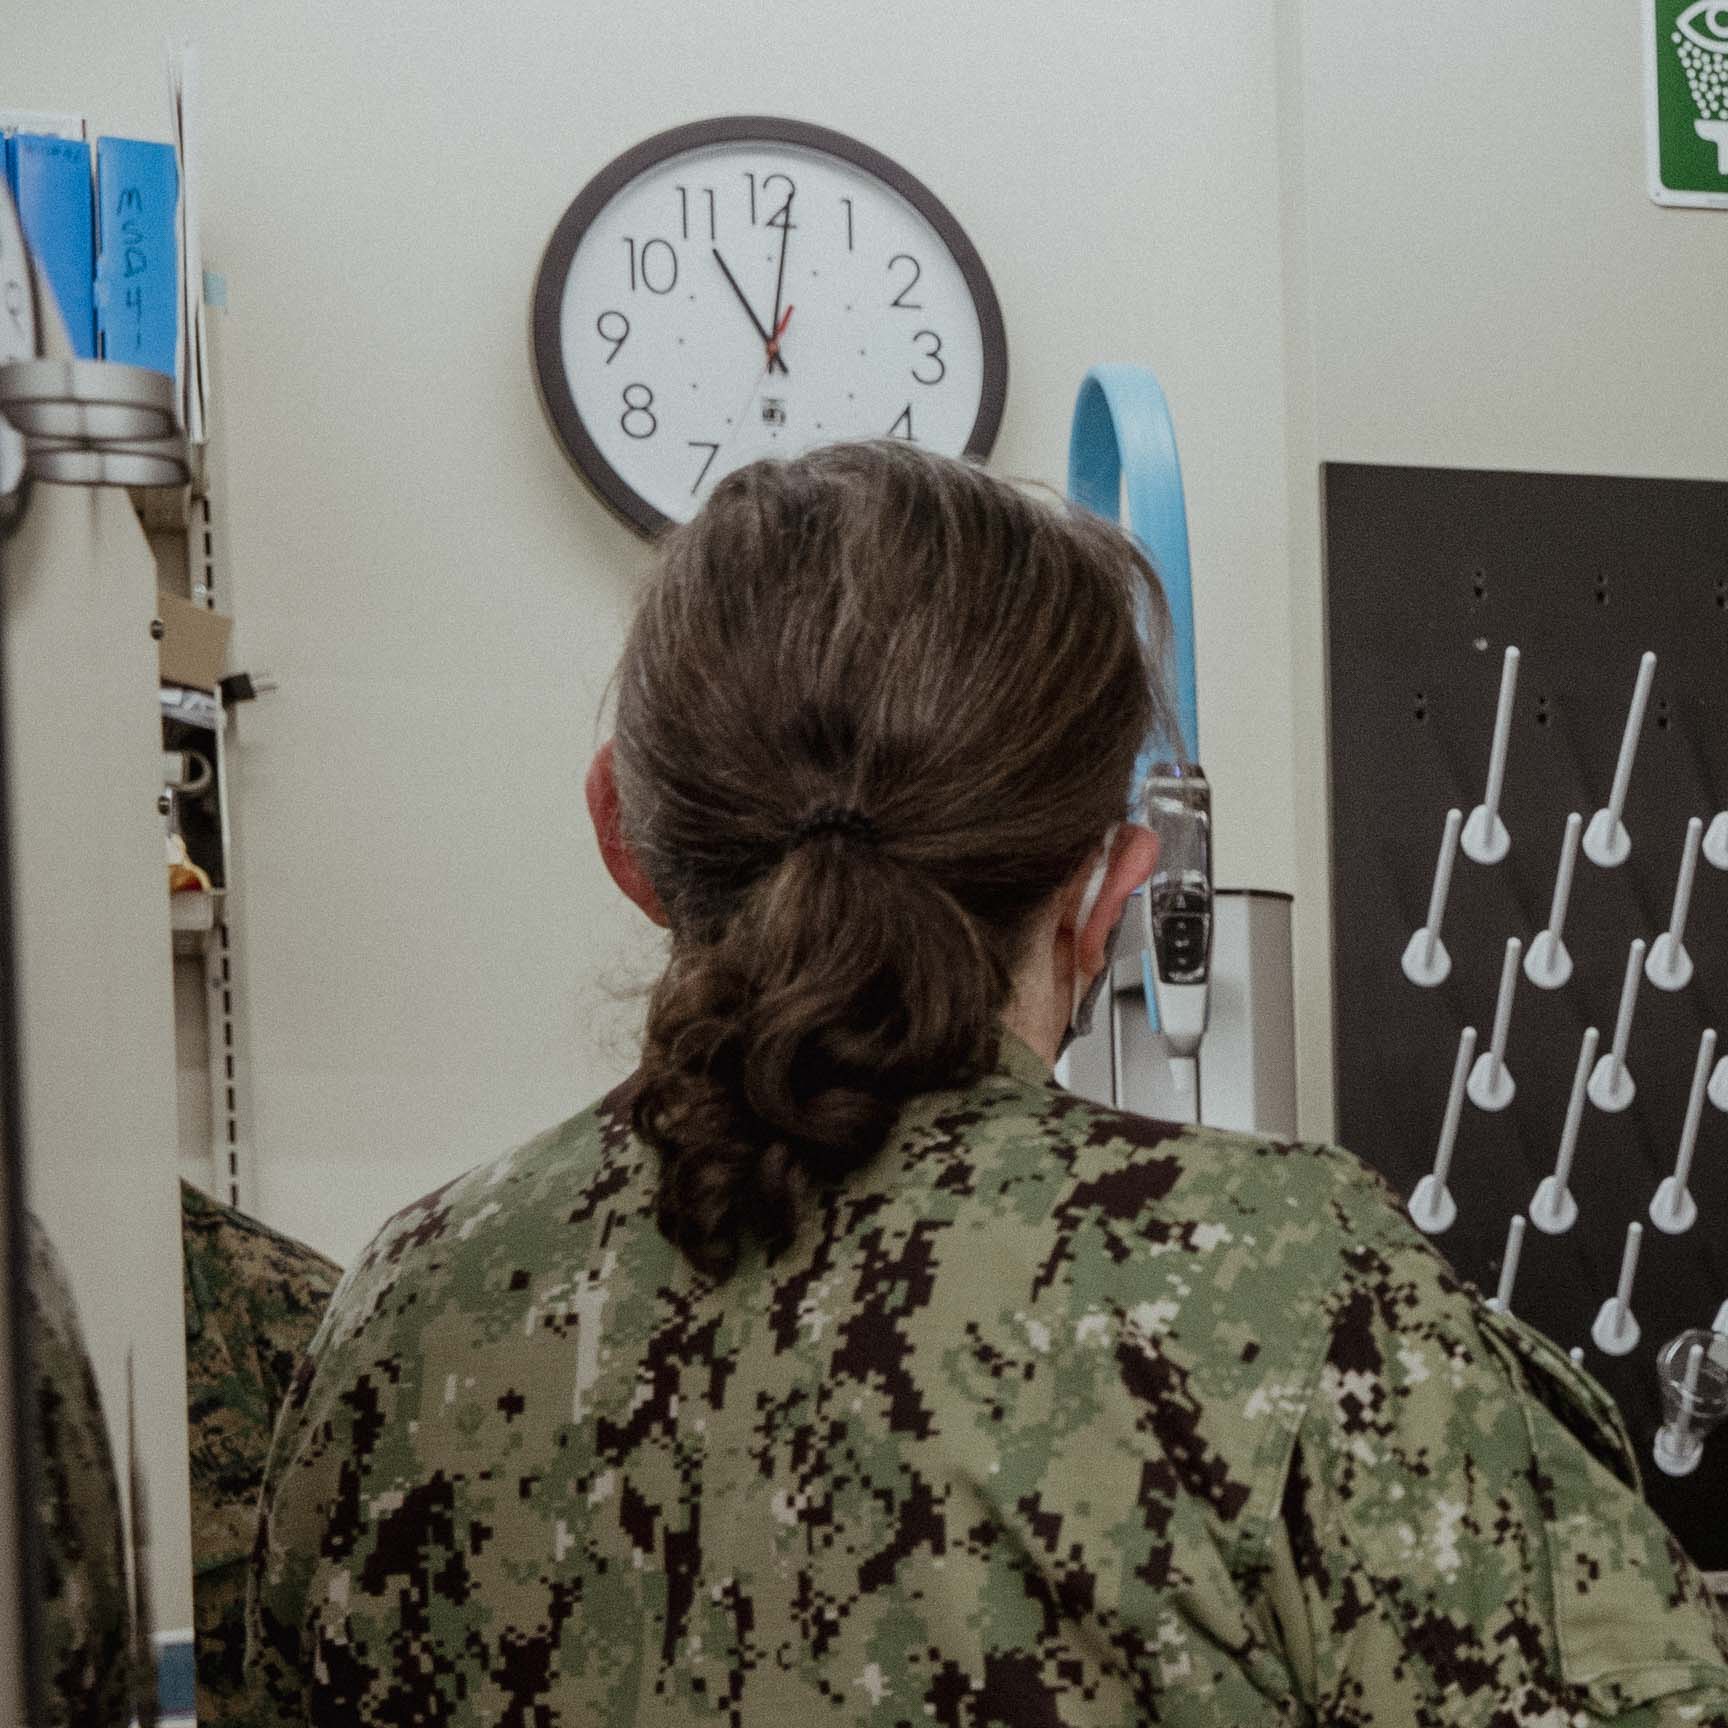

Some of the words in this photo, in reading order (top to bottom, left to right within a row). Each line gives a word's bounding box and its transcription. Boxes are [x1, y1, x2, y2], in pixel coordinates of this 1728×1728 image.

[677, 186, 716, 240] 11
[745, 173, 798, 230] 12
[841, 198, 853, 252] 1
[623, 237, 677, 294] 10
[888, 254, 922, 310] 2
[596, 310, 630, 365] 9
[911, 330, 945, 385] 3
[620, 383, 657, 439] 8
[888, 401, 918, 441] 4
[687, 441, 720, 495] 7
